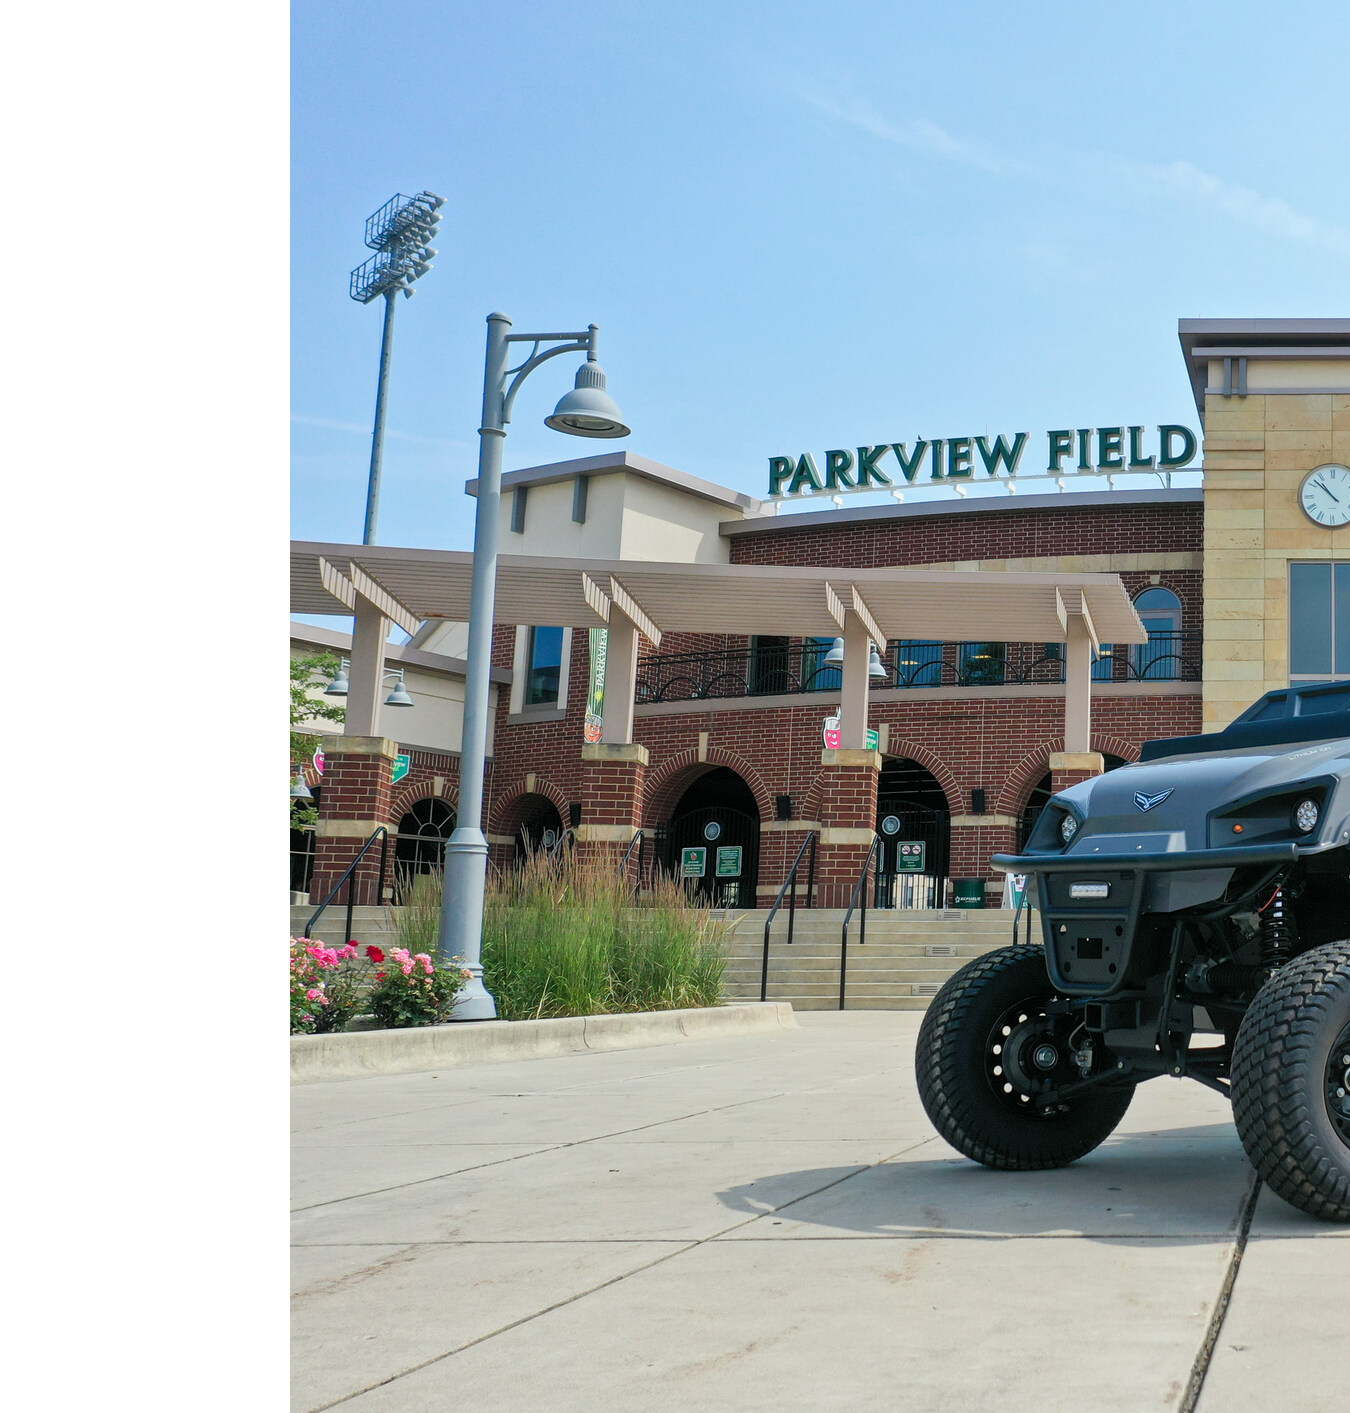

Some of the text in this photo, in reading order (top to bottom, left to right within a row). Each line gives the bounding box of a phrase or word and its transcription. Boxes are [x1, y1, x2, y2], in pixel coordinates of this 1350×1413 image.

[768, 424, 1198, 496] PARKVIEW FIELD
[596, 628, 608, 686] PARKVIEW
[1288, 750, 1317, 760] LITHIUM
